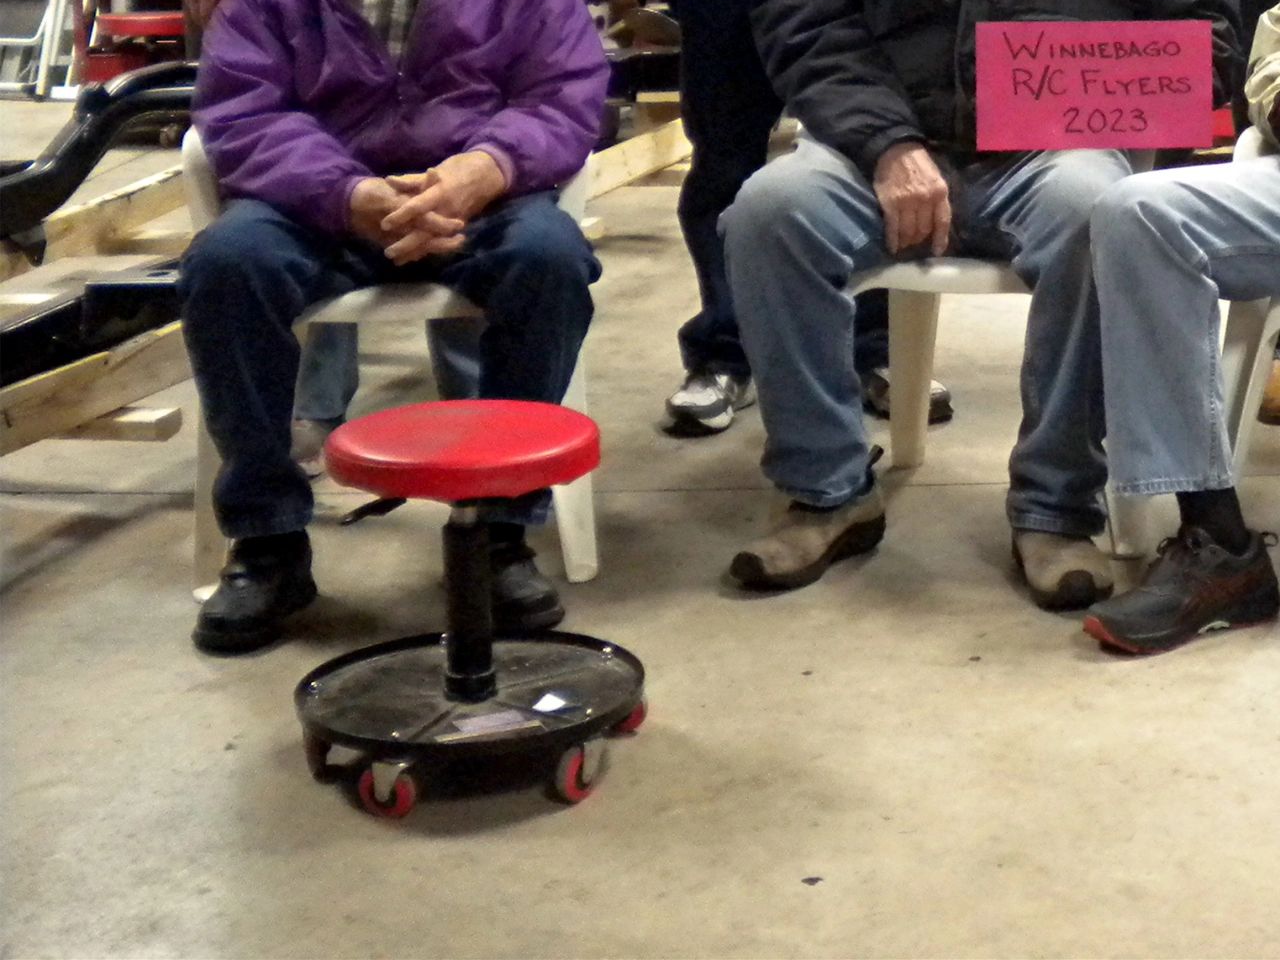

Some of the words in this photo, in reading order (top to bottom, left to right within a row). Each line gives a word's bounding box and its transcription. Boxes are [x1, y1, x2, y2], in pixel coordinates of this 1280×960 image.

[1003, 30, 1181, 60] WINNEBAGO
[1012, 65, 1067, 100] R/C
[1081, 69, 1192, 96] FLYERS
[1063, 107, 1148, 133] 2023
